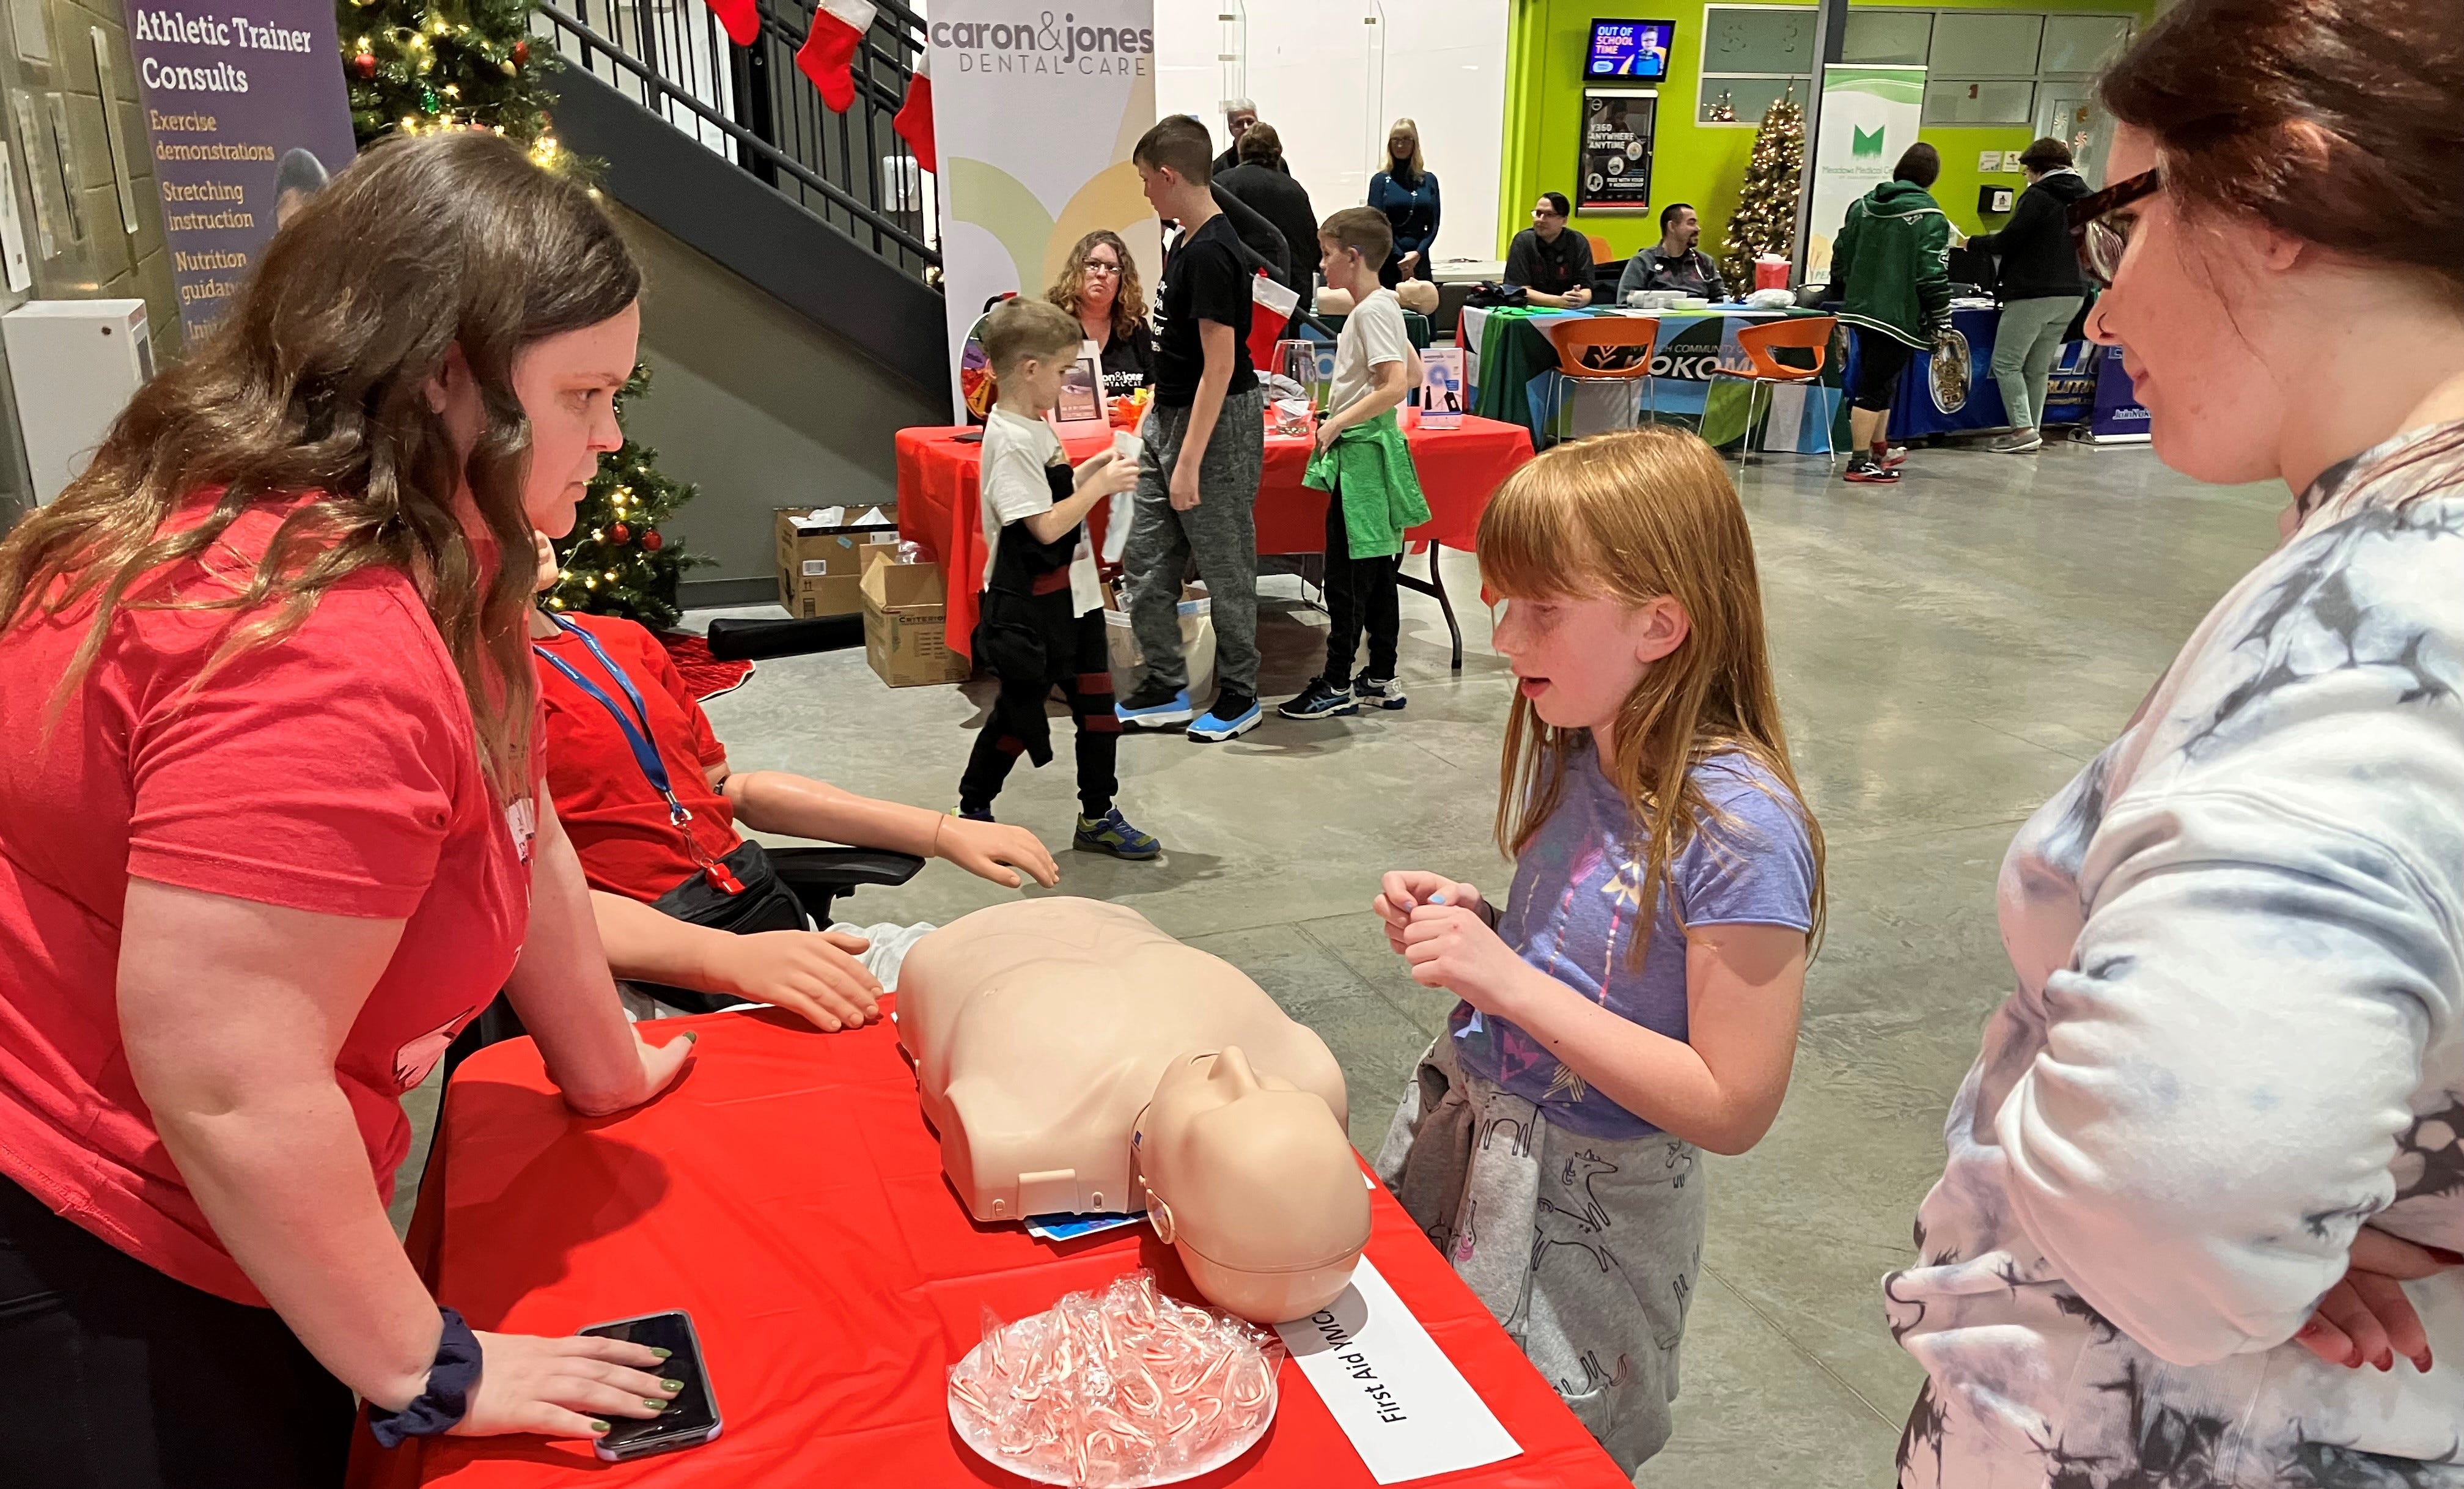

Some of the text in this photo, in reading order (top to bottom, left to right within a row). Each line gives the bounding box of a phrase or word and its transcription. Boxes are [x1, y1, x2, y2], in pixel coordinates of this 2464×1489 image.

[136, 10, 311, 53] Athletic Trainer
[932, 11, 1153, 64] caron&jones
[1595, 36, 1634, 46] SCHOOL
[1597, 26, 1634, 36] OUT OF
[1595, 45, 1619, 54] TIME
[142, 57, 249, 93] Consults
[960, 53, 1146, 76] DENTAL CARE
[150, 109, 217, 131] Exercise
[1589, 132, 1635, 141] ANYWHERE
[156, 140, 275, 161] demonstrations
[162, 181, 243, 205] Stretching
[169, 209, 254, 231] instruction
[175, 249, 247, 272] Nutrition
[1623, 355, 1758, 381] KOKOM
[1338, 1353, 1378, 1379] Aid
[1364, 1384, 1407, 1423] First
